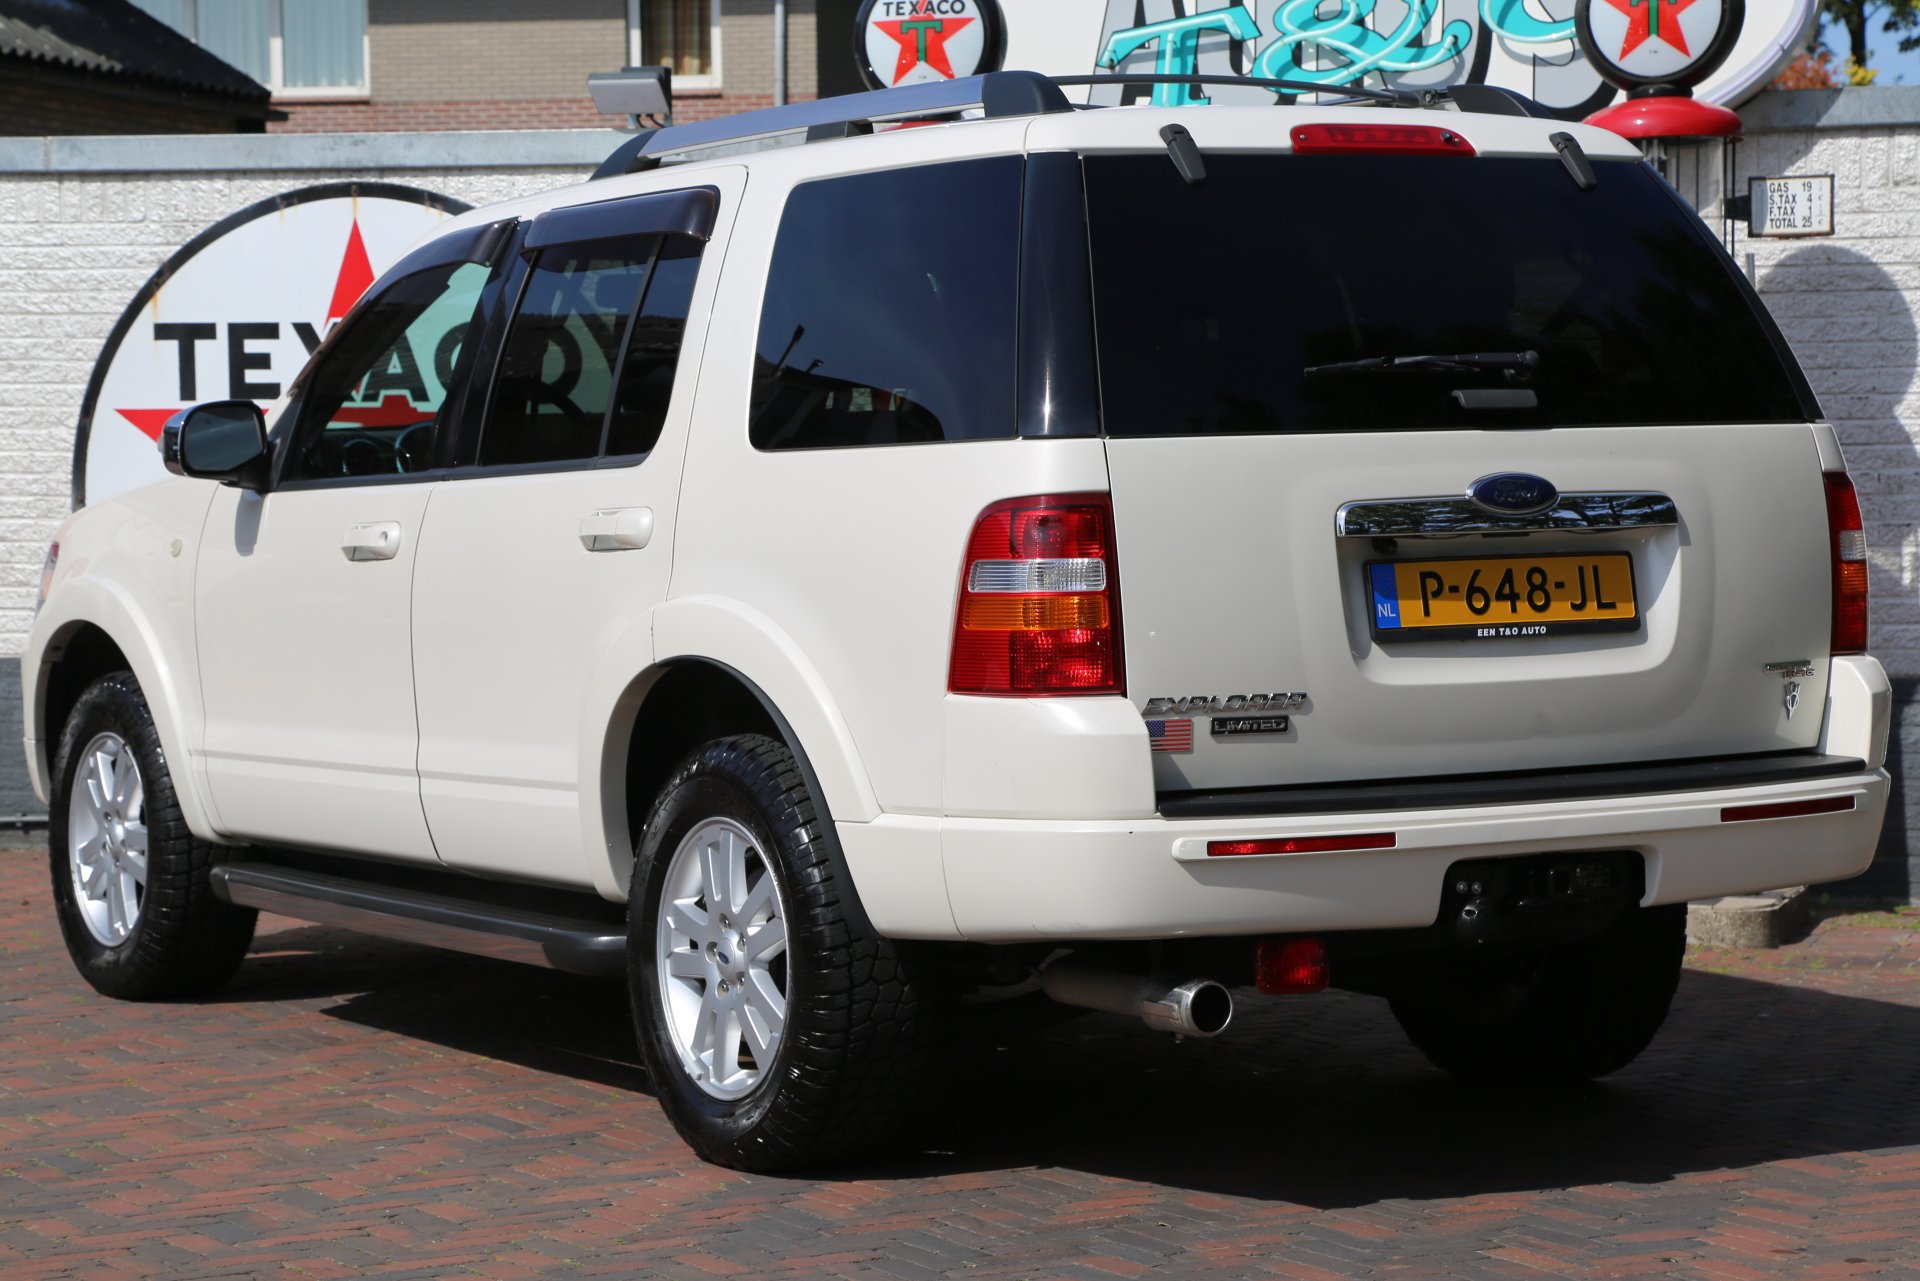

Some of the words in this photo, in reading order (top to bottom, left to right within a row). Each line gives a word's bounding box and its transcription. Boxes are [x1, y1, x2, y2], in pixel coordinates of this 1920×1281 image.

[882, 0, 966, 17] TEXACO
[1769, 182, 1790, 194] GAS
[1802, 181, 1812, 192] 19
[1769, 193, 1797, 205] S.TAX
[1807, 193, 1813, 203] 4
[1769, 205, 1796, 217] F.TAX
[1769, 216, 1798, 229] TOTAL
[1802, 217, 1813, 228] 25
[1418, 564, 1618, 618] P-648-JL
[1377, 602, 1397, 618] NL
[1477, 628, 1496, 637] EEN
[1499, 627, 1519, 636] T&O
[1521, 626, 1547, 635] AUTO
[1140, 692, 1307, 715] EXPLORER
[1213, 718, 1287, 732] LIMITED
